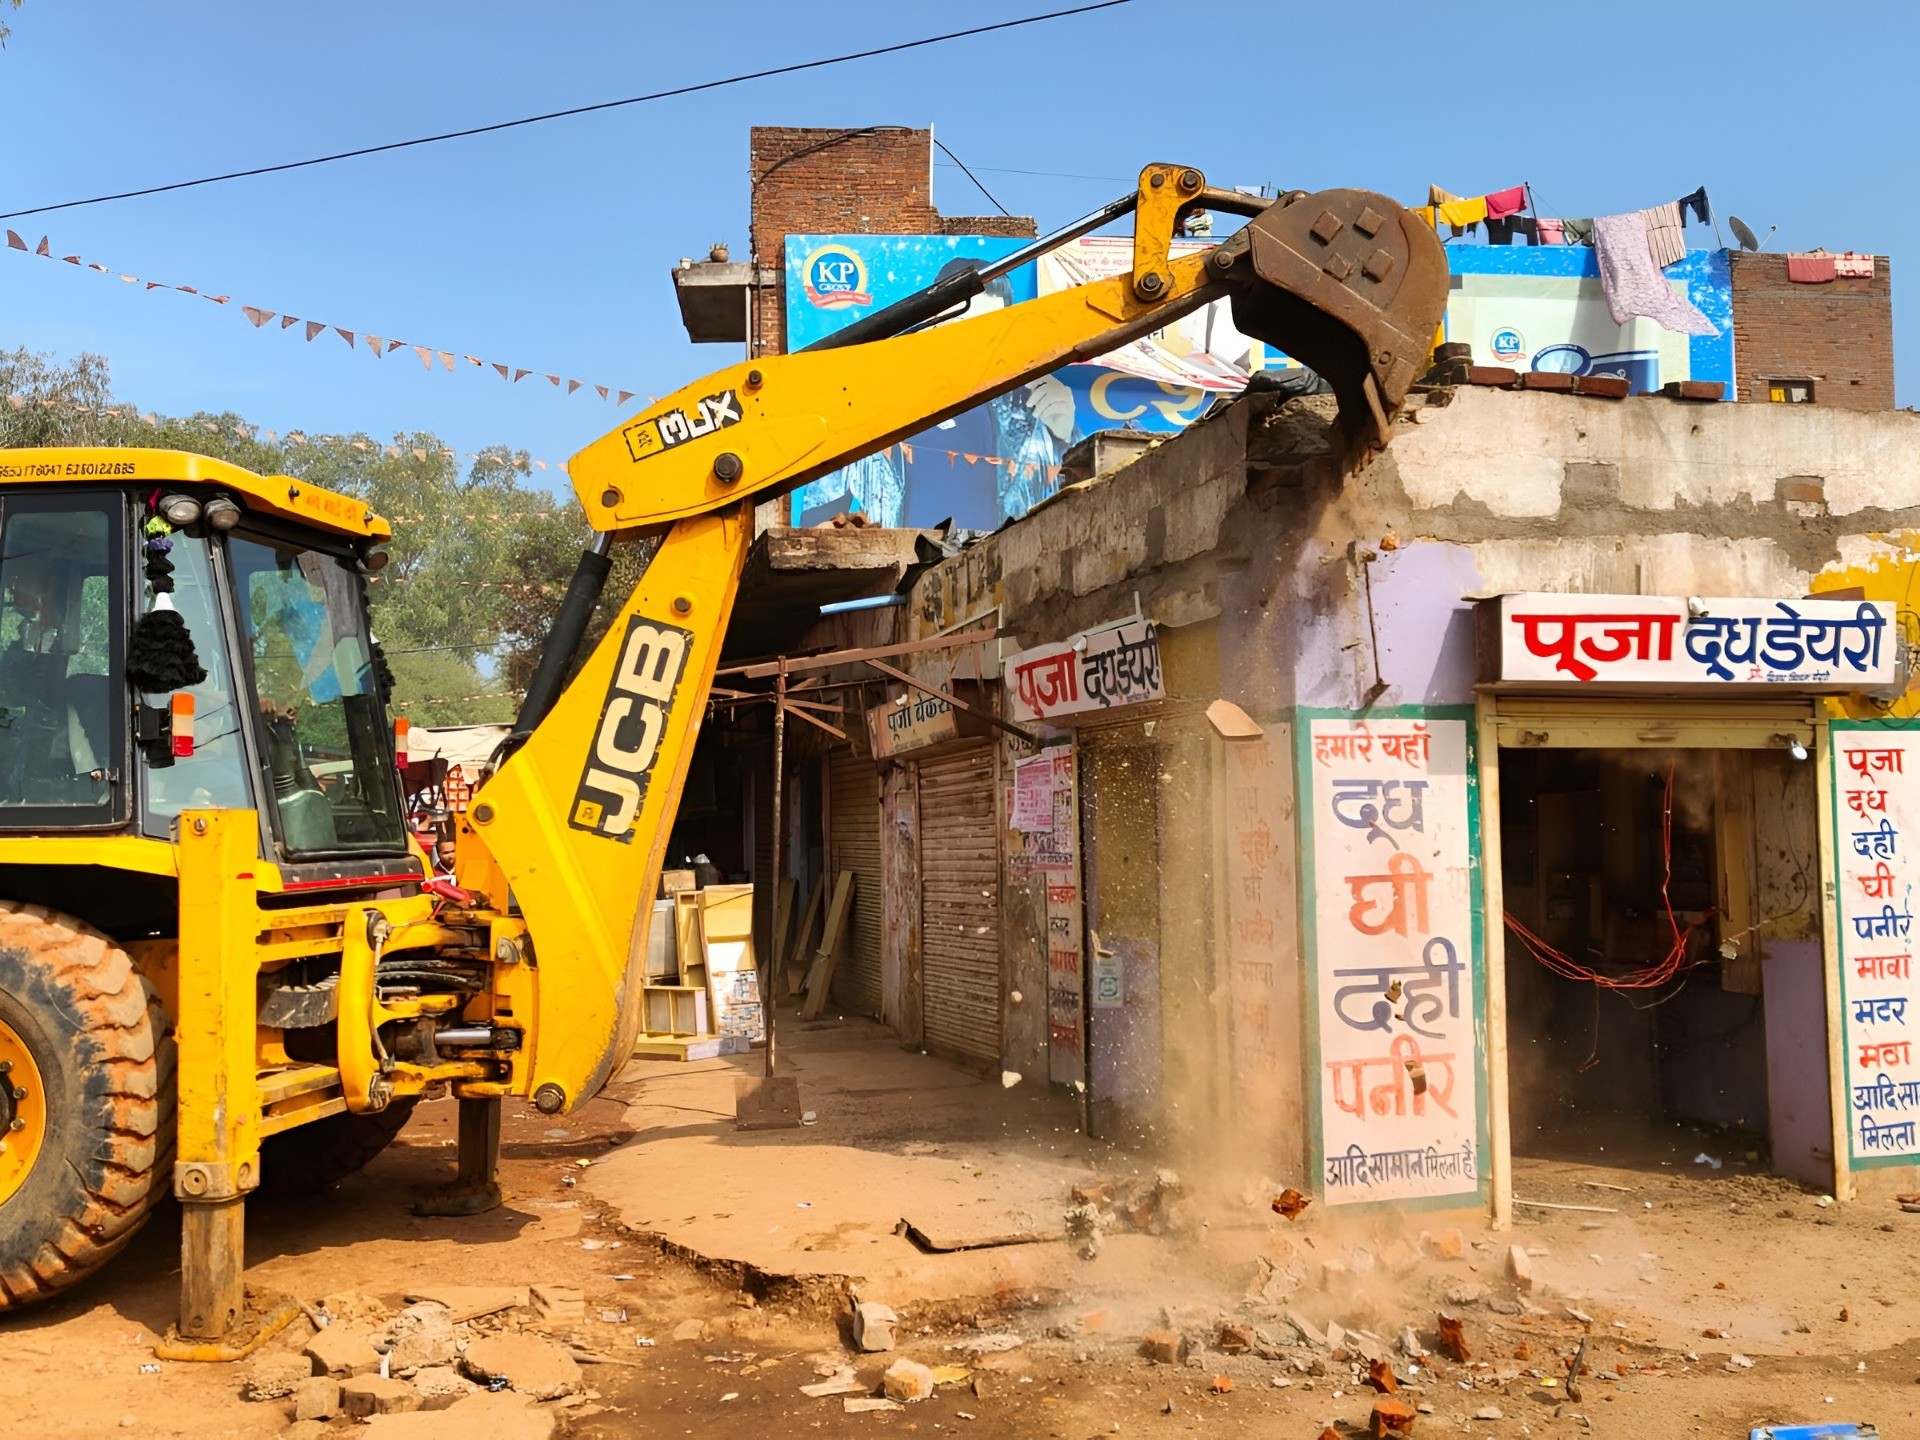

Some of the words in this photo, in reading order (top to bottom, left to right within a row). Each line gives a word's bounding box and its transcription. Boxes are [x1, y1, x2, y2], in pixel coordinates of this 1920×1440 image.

[818, 261, 855, 283] KP
[1511, 614, 1680, 681] पूजा
[1015, 650, 1077, 719] पूजा
[586, 625, 686, 835] JCB
[1314, 723, 1374, 768] हमारे
[1844, 749, 1905, 785] पूजा
[1332, 779, 1429, 850] दूध
[1846, 790, 1888, 825] दूध
[1852, 818, 1898, 860] दही
[1344, 852, 1434, 938] घी
[1858, 862, 1895, 899] घी
[1853, 905, 1913, 941] पनीर
[1855, 954, 1911, 980] मावा
[1333, 936, 1466, 1039] दही
[1852, 998, 1908, 1026] मटर
[1326, 1034, 1459, 1122] पनीर
[1853, 1073, 1898, 1111] आदि
[1860, 1114, 1915, 1150] मिलता
